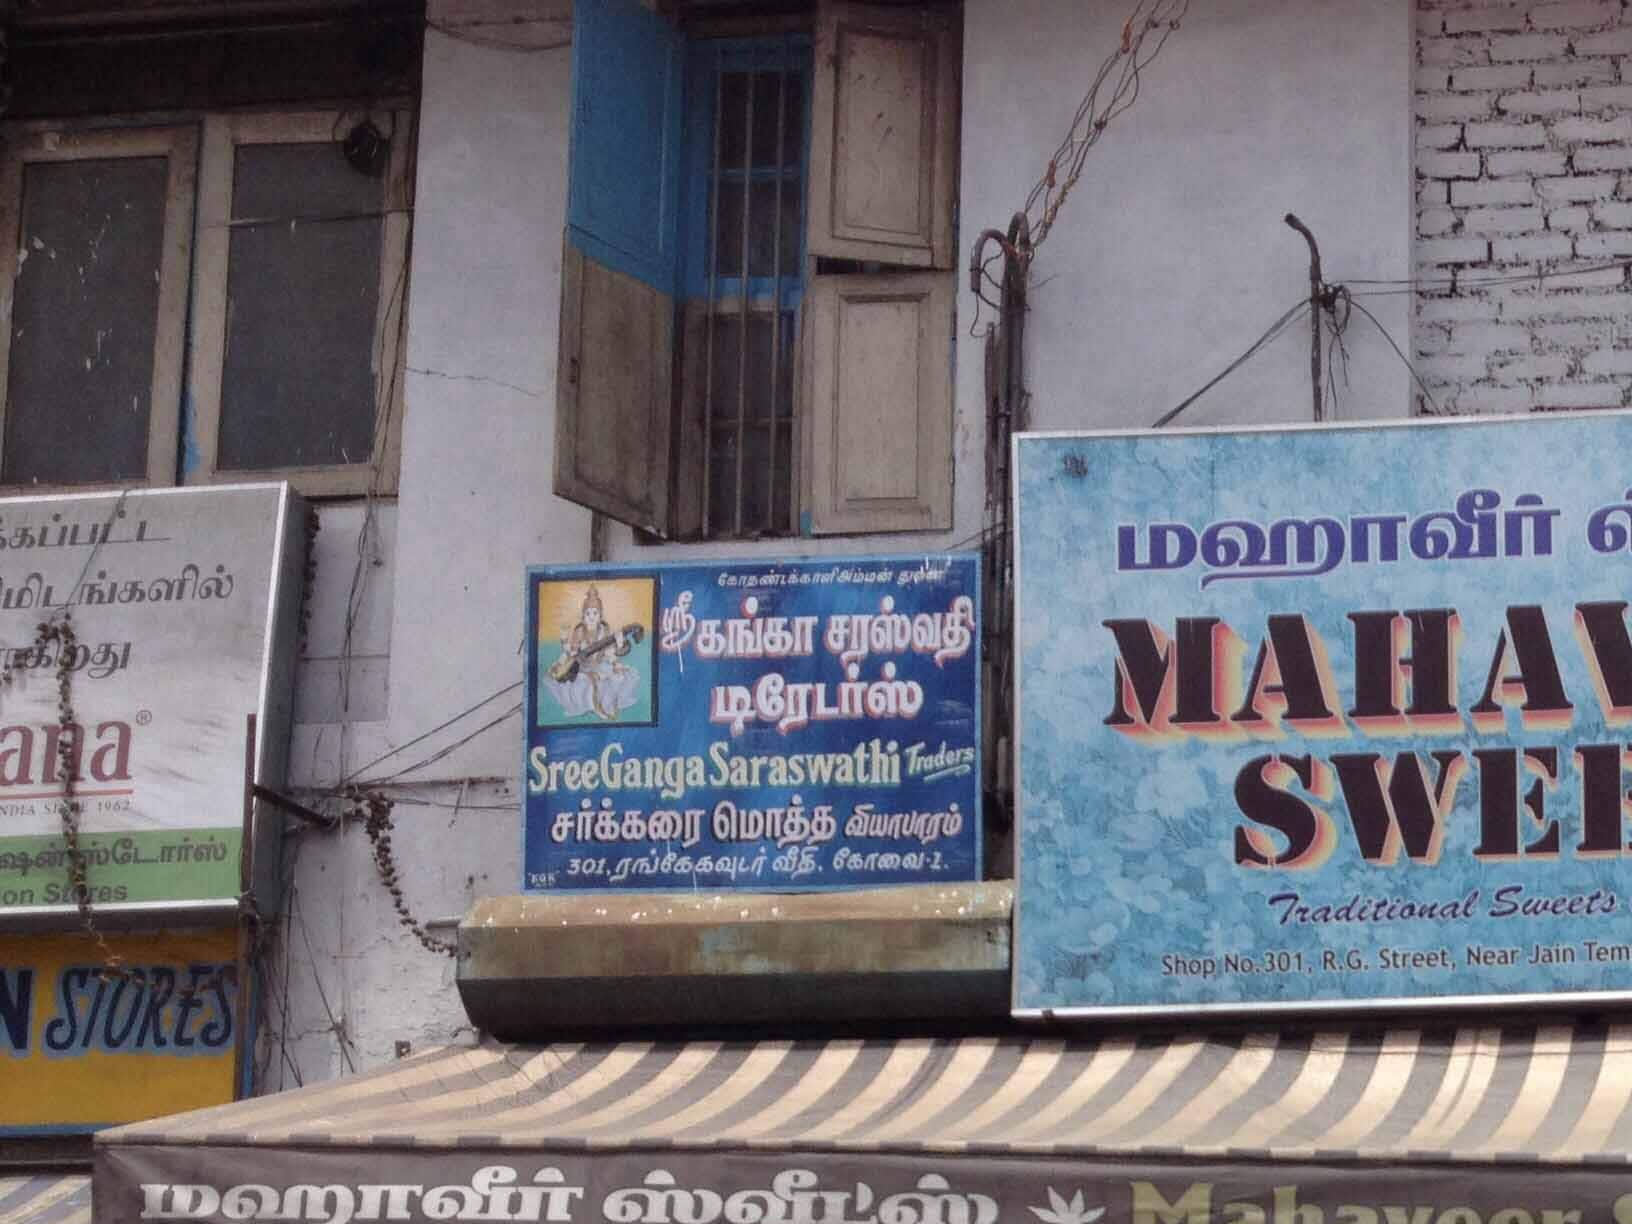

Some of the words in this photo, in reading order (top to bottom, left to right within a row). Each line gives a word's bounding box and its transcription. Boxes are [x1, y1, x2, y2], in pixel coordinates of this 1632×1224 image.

[1116, 490, 1560, 589] மஹாவீர்
[0, 564, 234, 610] மிடங்களில்
[697, 597, 817, 658] கங்கா
[825, 596, 976, 667] சரஸ்வதி
[529, 745, 600, 793] Sree
[602, 741, 706, 799] Ganga
[709, 740, 900, 790] Saraswathi
[904, 745, 976, 776] Traders
[714, 795, 837, 848] மொத்த
[44, 881, 128, 904] Stres
[1268, 888, 1480, 926] Traditional
[1490, 884, 1617, 918] Sweets
[1161, 954, 1215, 979] Shop
[1224, 950, 1312, 975] No.301,
[1322, 948, 1369, 971] R.G.
[1379, 943, 1457, 970] Street,
[1467, 945, 1520, 967] Near
[1528, 943, 1576, 967] Jain
[46, 962, 236, 1052] STORES
